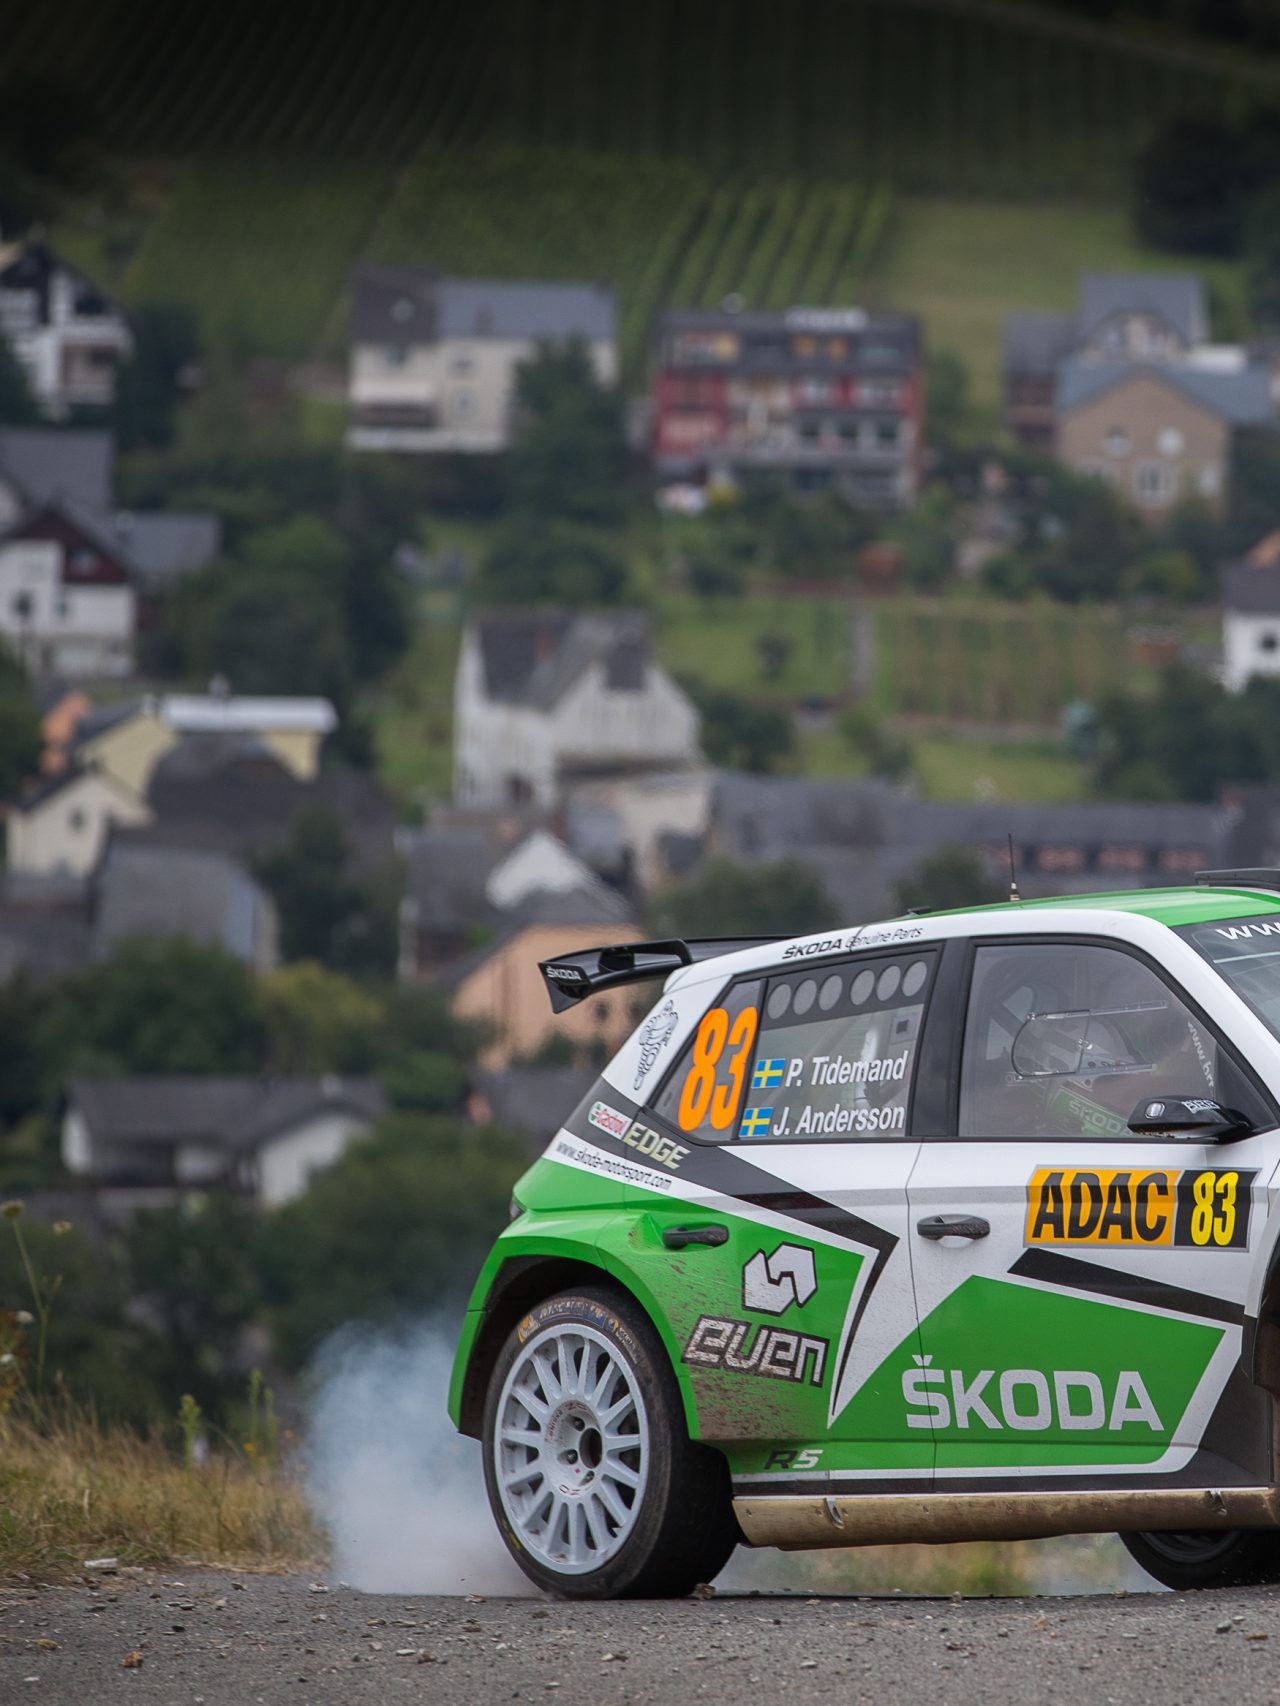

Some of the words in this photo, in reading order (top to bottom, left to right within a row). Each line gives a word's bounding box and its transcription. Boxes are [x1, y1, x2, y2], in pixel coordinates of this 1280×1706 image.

[782, 937, 843, 960] ŠKODA
[892, 927, 924, 940] Parts
[546, 965, 582, 980] ŠKODA
[677, 1006, 758, 1131] 83
[785, 1058, 804, 1087] P.
[811, 1050, 909, 1086] Tidemand
[772, 1111, 790, 1137] J.
[795, 1104, 906, 1136] Andersson
[622, 1121, 692, 1170] EDGE
[1031, 1171, 1170, 1242] ADAC
[1190, 1171, 1240, 1247] 83
[901, 1354, 1165, 1431] ŠKODA
[763, 1449, 824, 1470] R5
